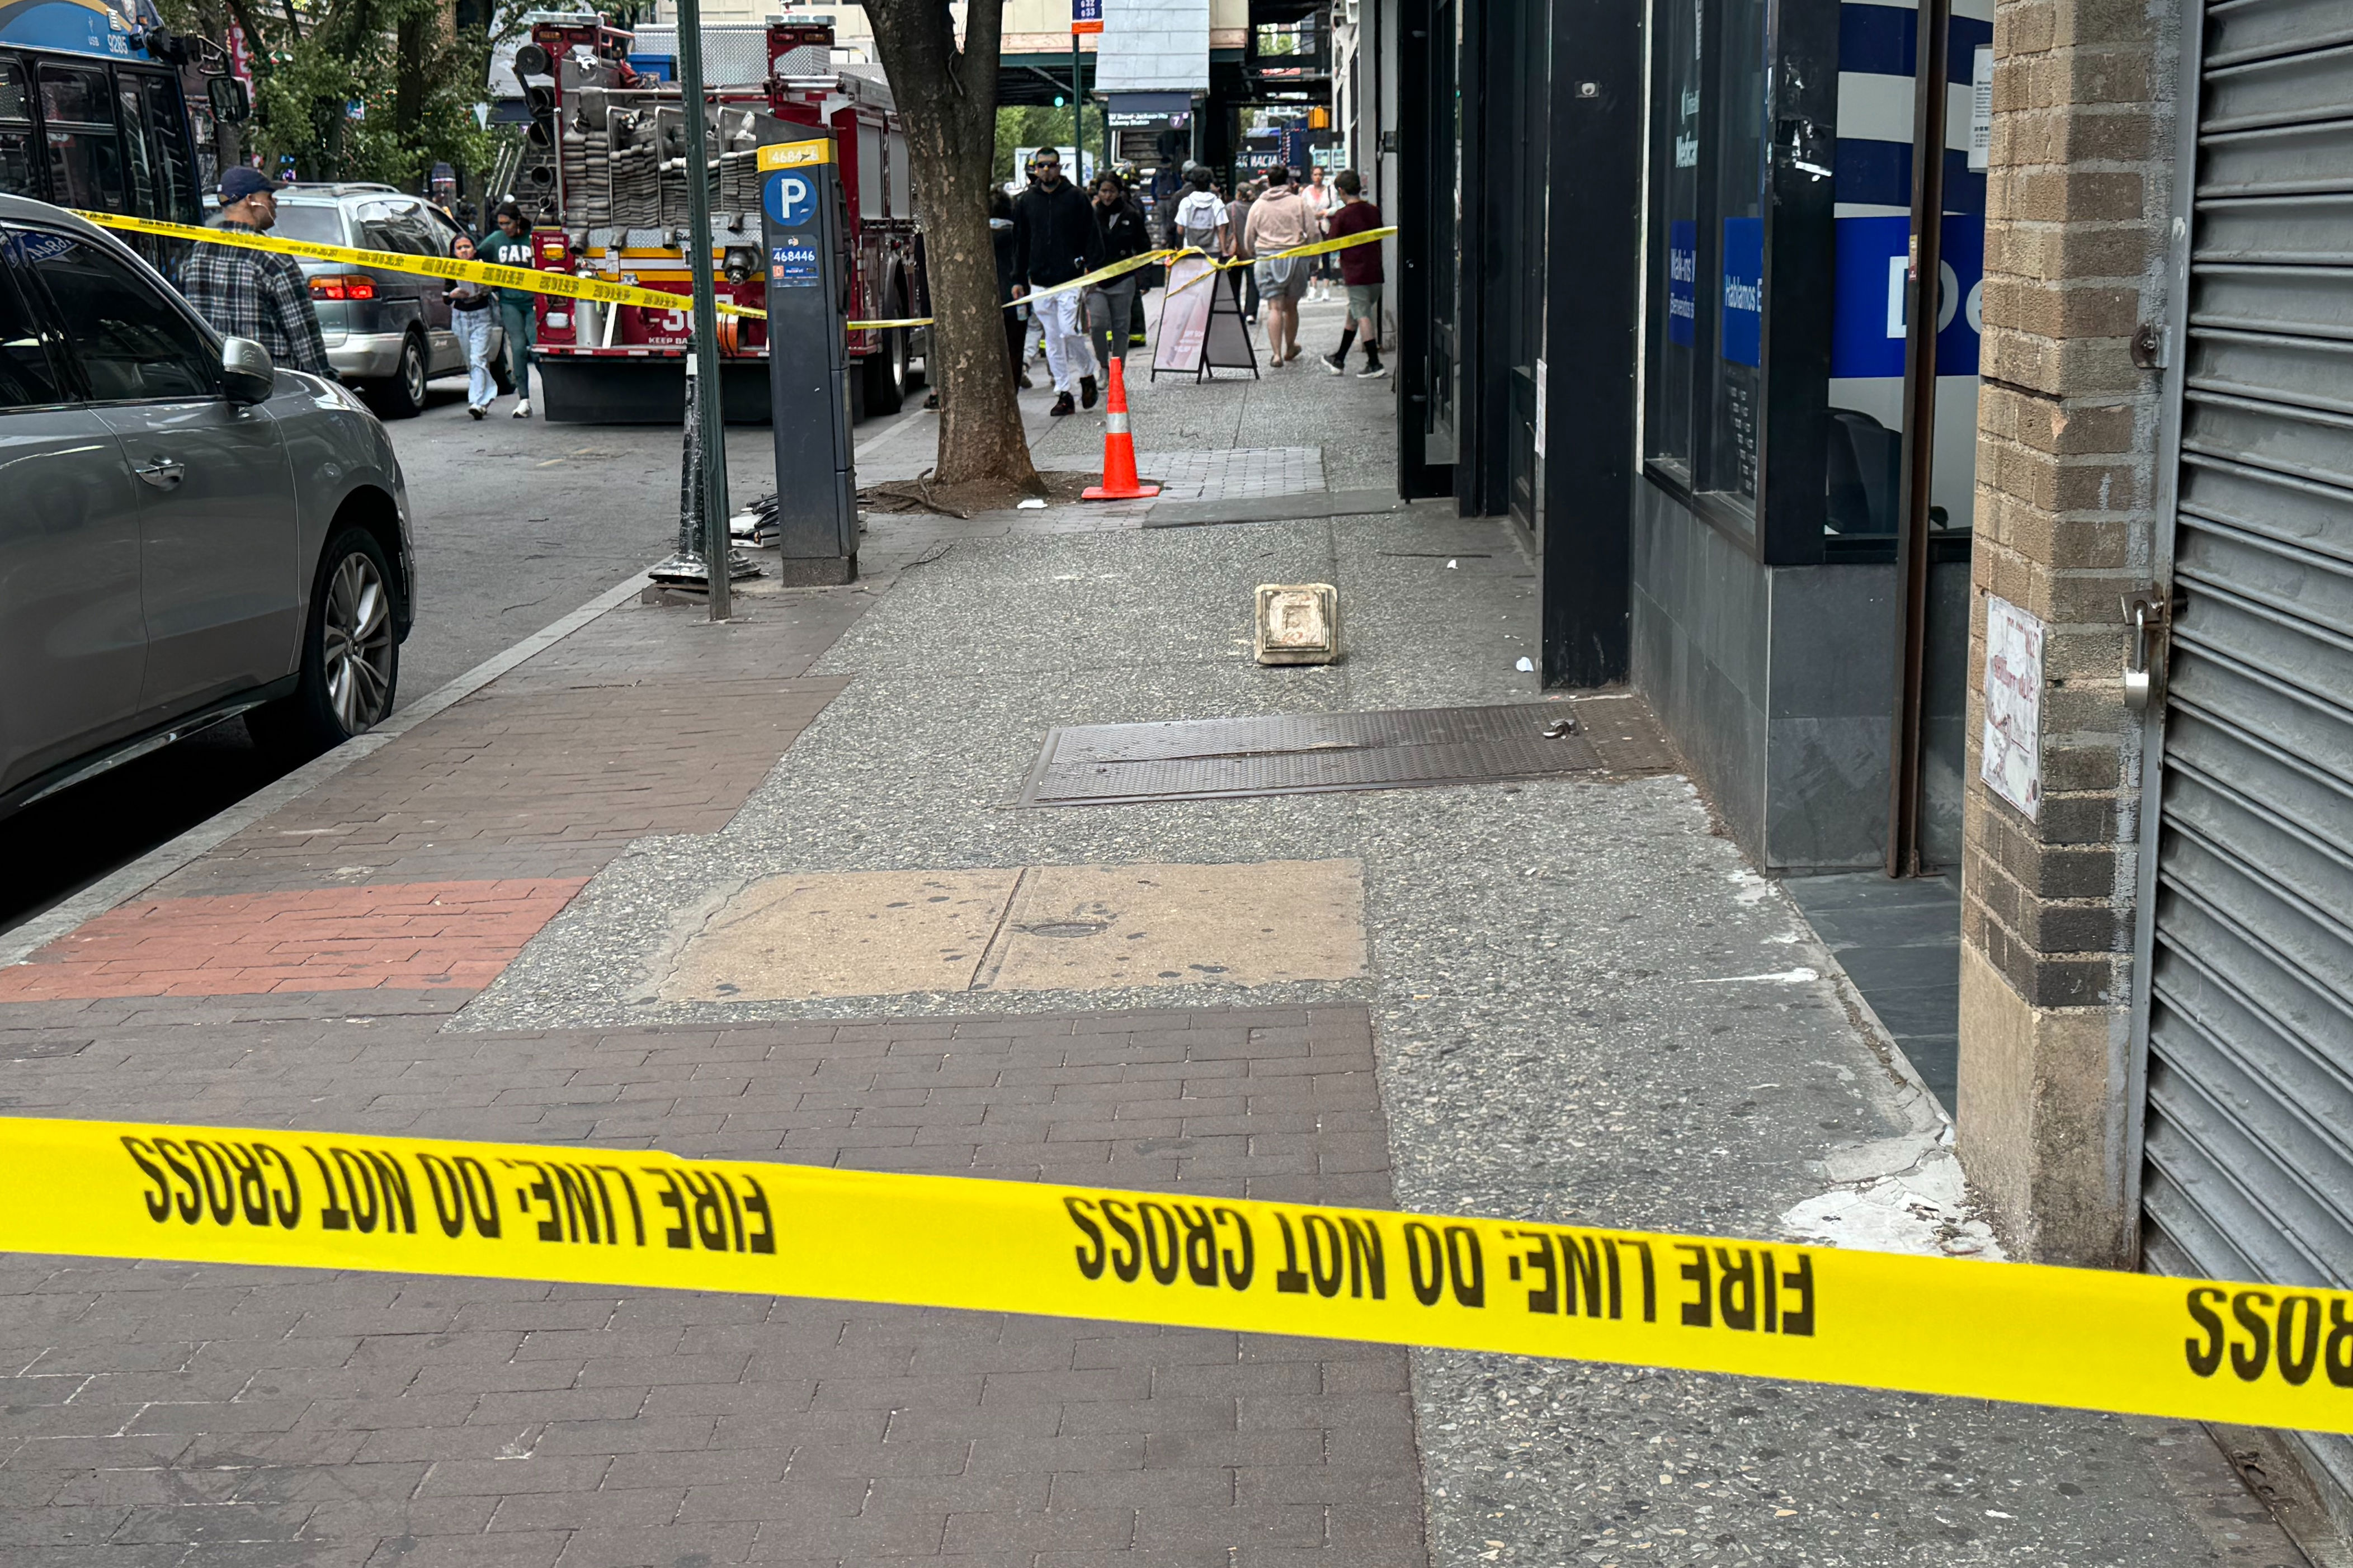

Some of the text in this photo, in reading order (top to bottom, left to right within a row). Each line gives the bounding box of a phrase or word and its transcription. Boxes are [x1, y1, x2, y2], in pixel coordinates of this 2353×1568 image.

[107, 34, 128, 54] 9285
[781, 178, 807, 219] P
[498, 244, 531, 263] GAP
[773, 251, 815, 262] 468446
[1725, 274, 1756, 311] Hablamos
[120, 1137, 775, 1254] FIRE LINE: DO NOT CROSS
[1065, 1198, 1814, 1336] FIRE LINE: DO NOT CROSS
[2185, 1288, 2353, 1388] ROSS
